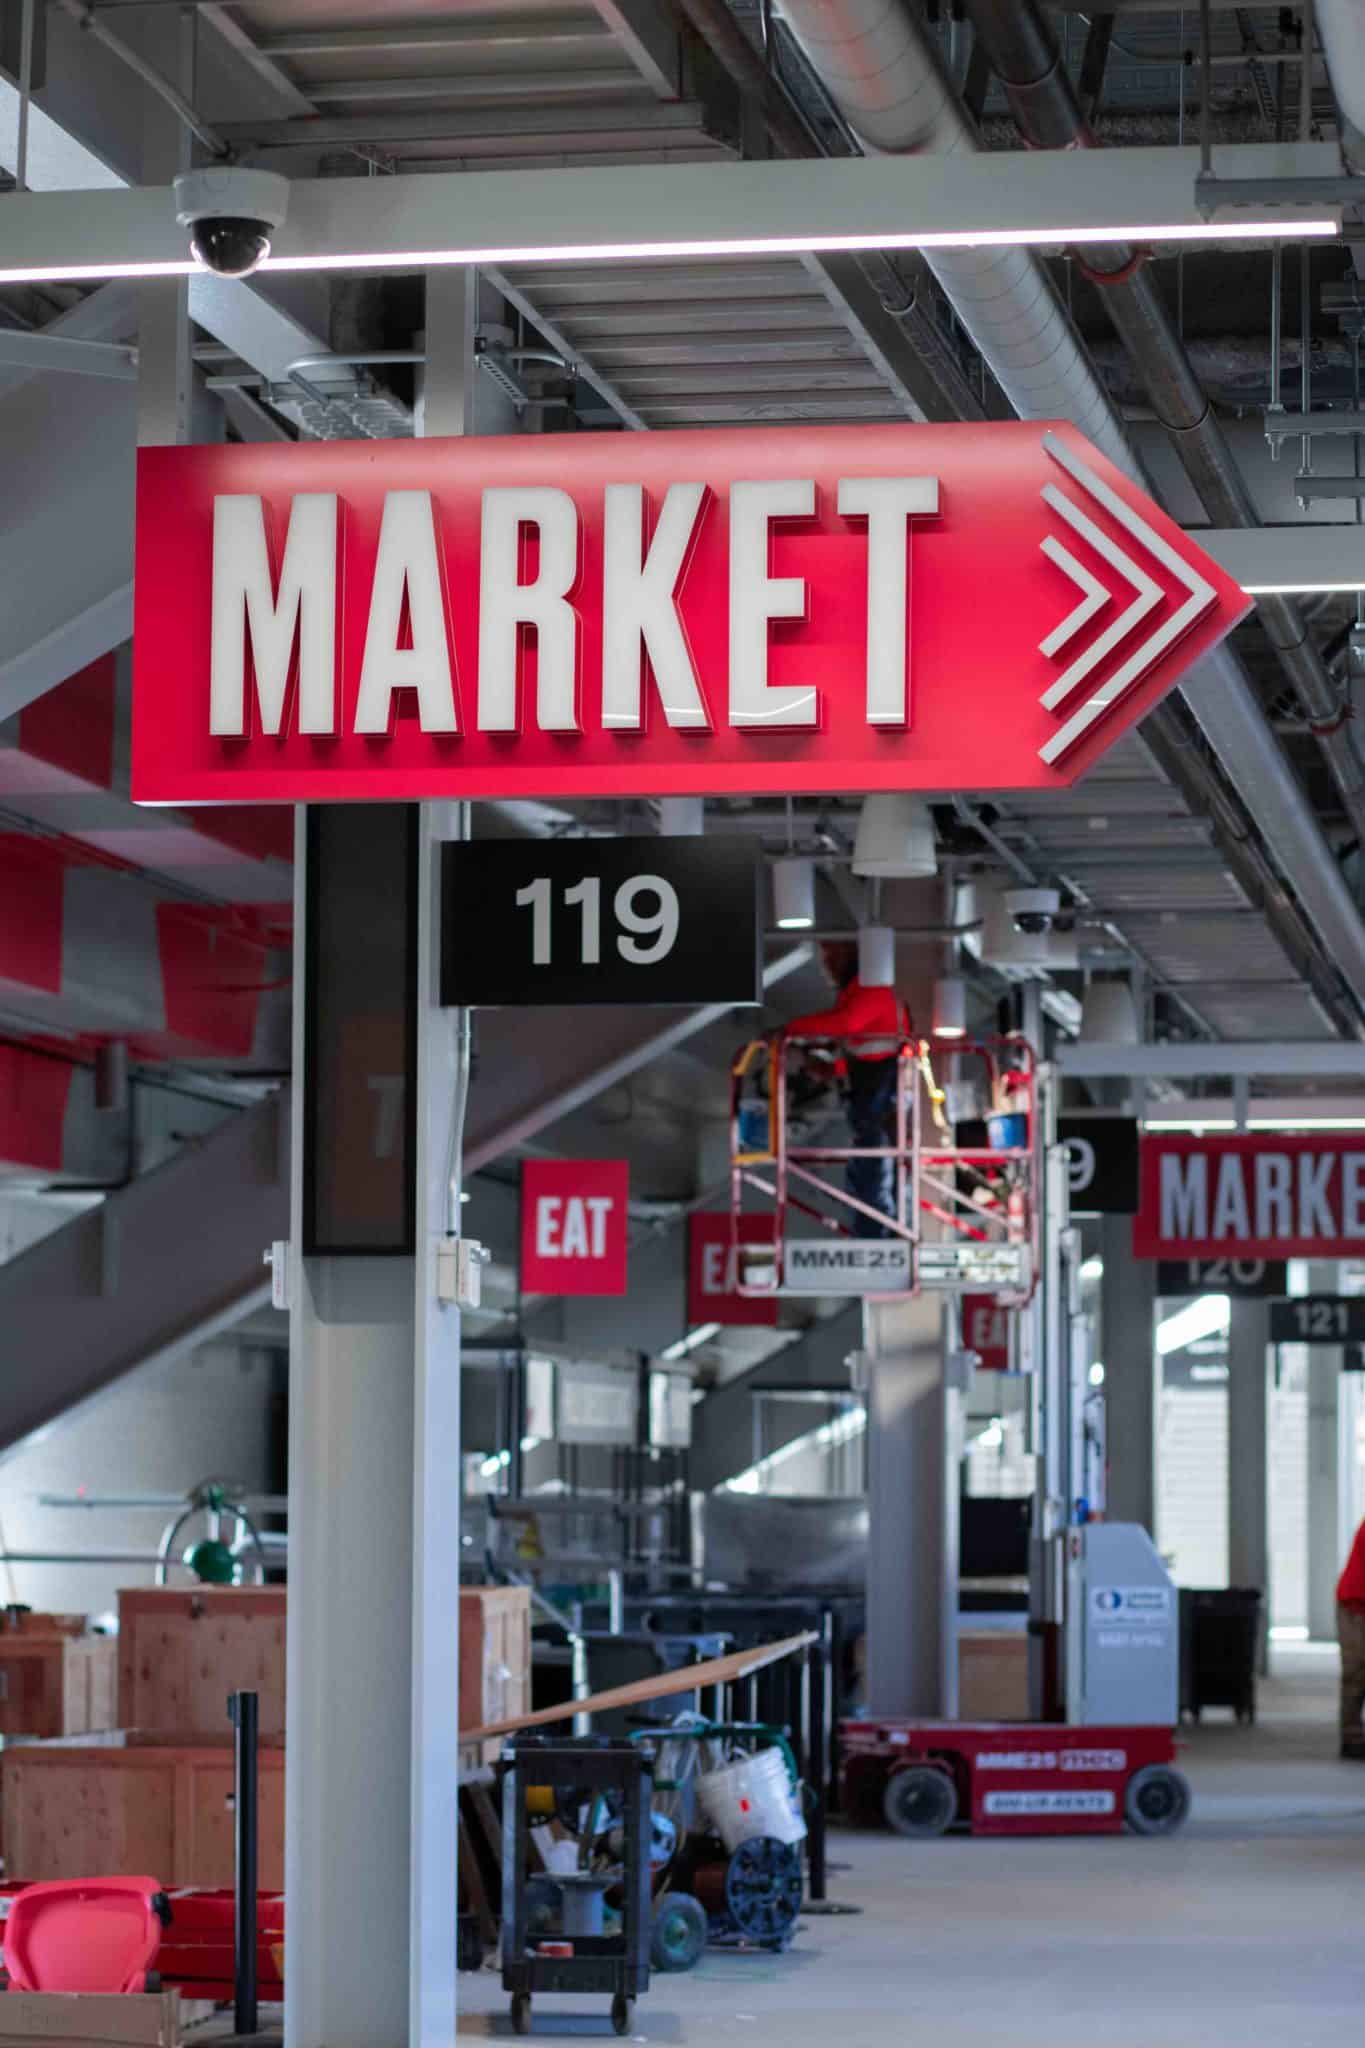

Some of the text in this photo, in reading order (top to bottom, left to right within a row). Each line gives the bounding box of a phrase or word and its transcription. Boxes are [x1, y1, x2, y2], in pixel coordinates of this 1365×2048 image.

[208, 475, 940, 737] MARKET
[515, 873, 680, 965] 119
[535, 1196, 614, 1258] EAT
[792, 1248, 906, 1270] MME25
[1295, 1302, 1349, 1336] 121
